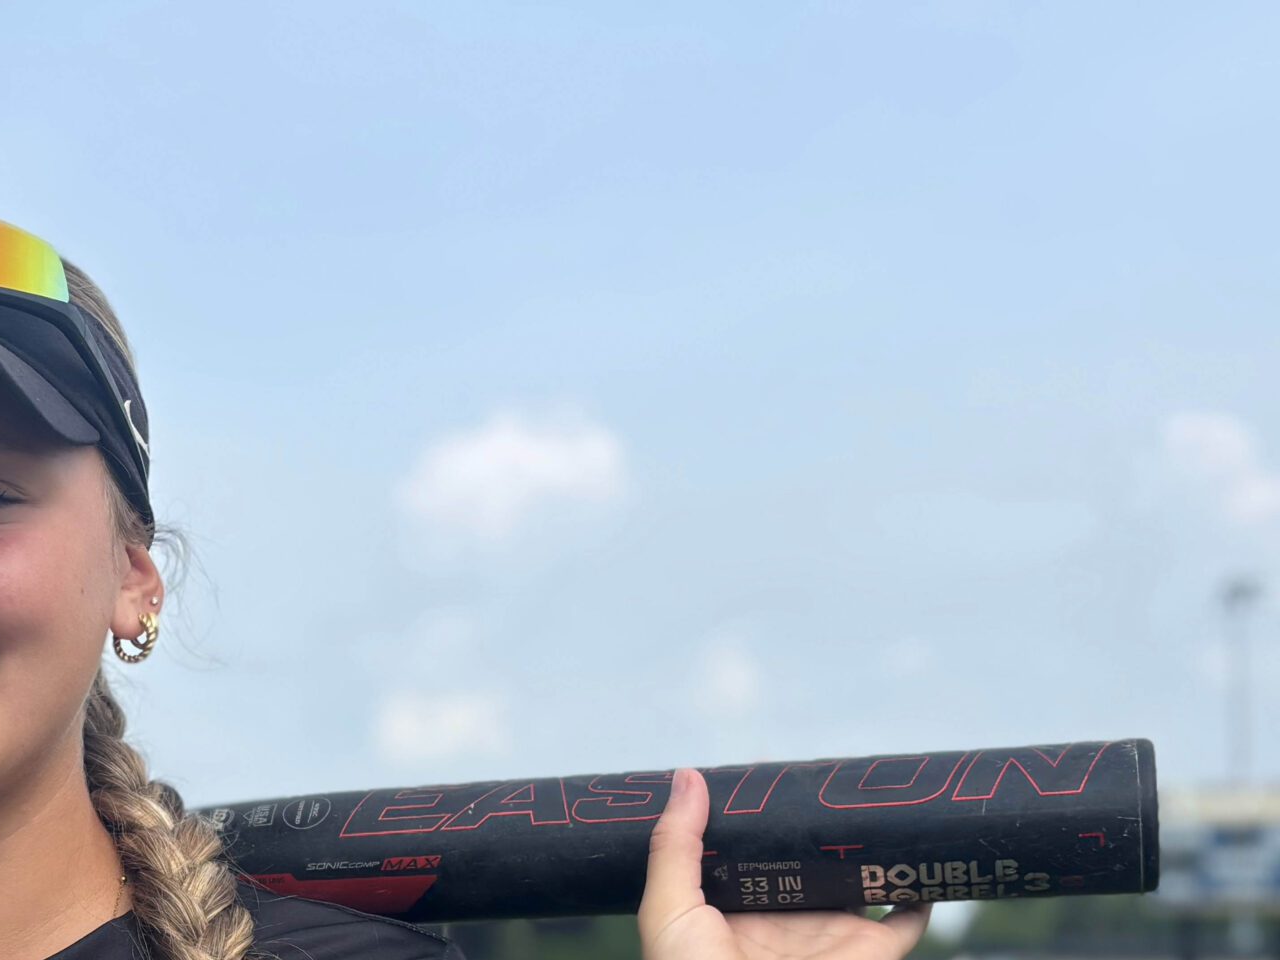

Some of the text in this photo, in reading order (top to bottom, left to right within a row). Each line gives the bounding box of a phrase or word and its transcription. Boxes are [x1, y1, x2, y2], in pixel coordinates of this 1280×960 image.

[340, 742, 1112, 838] EASTON
[381, 856, 440, 871] MAX
[861, 859, 1019, 888] DOUBLE
[739, 876, 802, 893] 33 IN
[741, 893, 805, 905] 23 OZ
